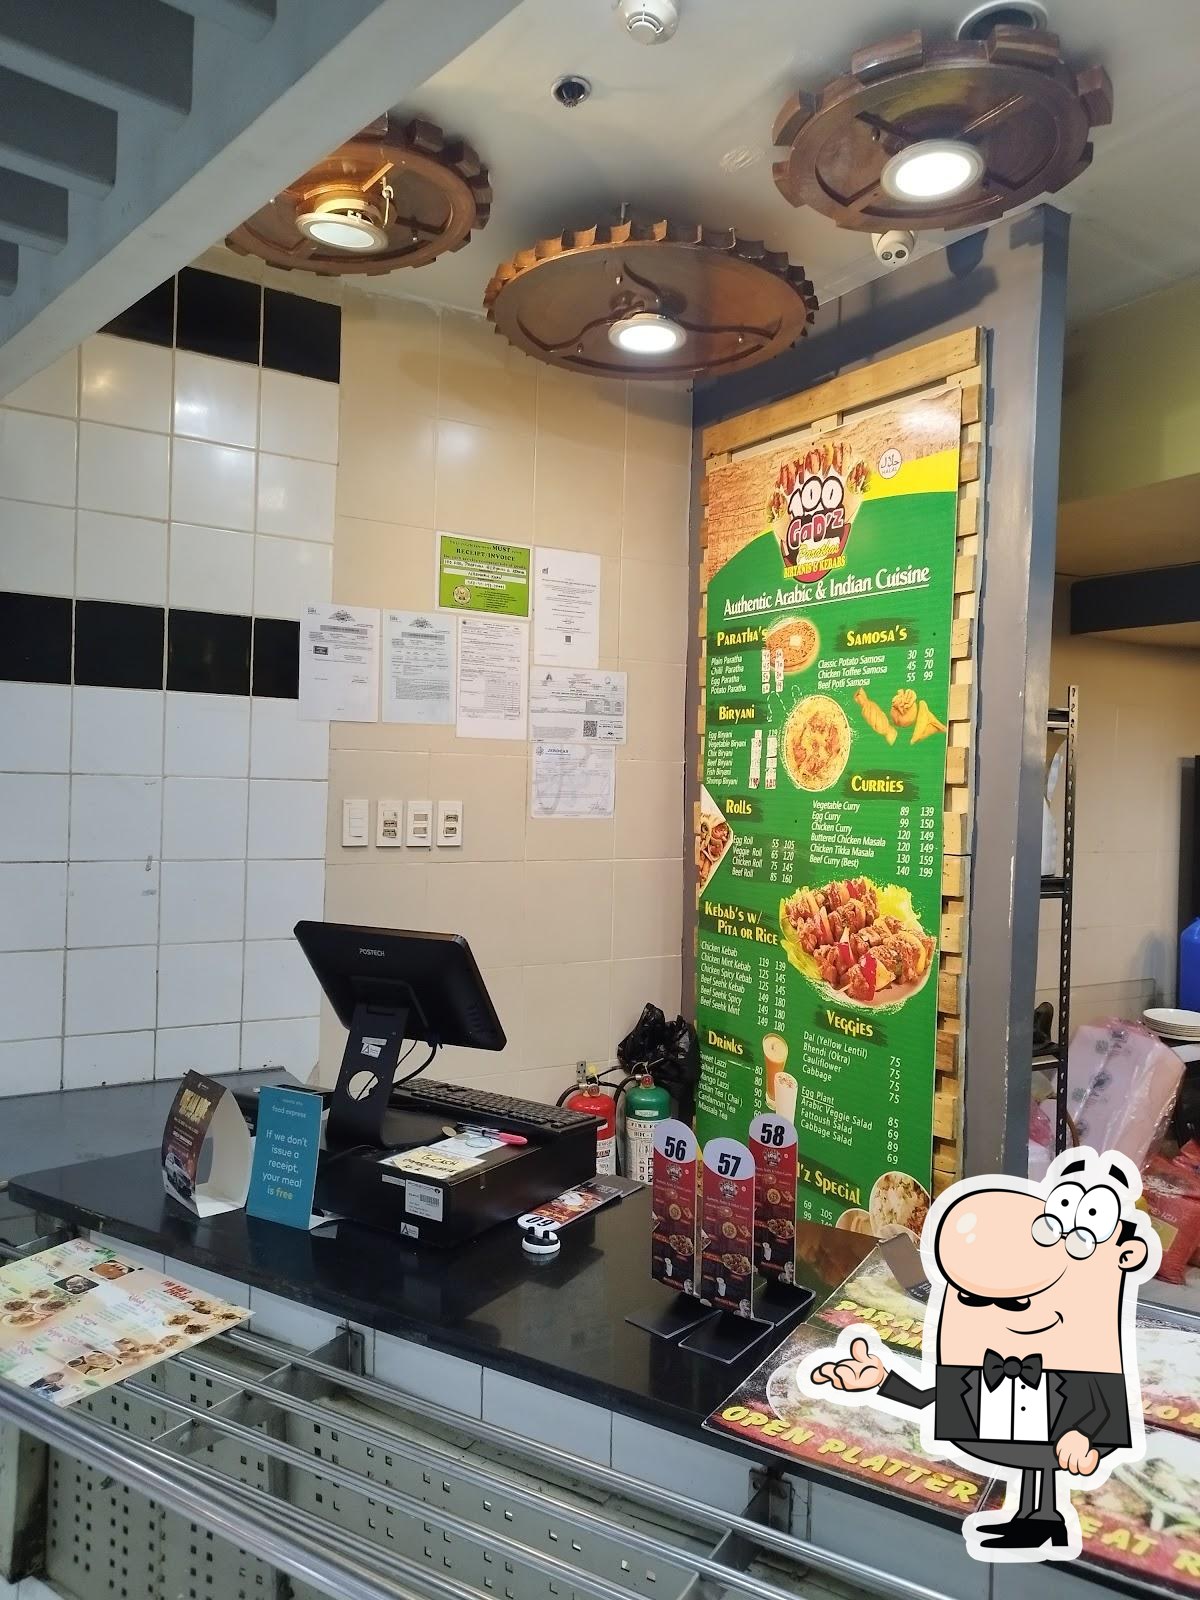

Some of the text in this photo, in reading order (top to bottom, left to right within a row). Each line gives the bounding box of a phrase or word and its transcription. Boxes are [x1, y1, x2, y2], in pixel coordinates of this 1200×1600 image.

[788, 476, 844, 518] 100
[723, 565, 931, 617] Authentic Arabic & Indian Cuisine
[907, 648, 934, 660] 30 50
[818, 655, 885, 669] Classic Potato Samosa
[906, 660, 934, 670] 45 70
[818, 669, 840, 679] Chicken
[862, 666, 887, 675] Samosa
[906, 671, 934, 682] 55 99
[818, 681, 830, 690] Beef
[846, 678, 870, 687] Samosa
[812, 800, 860, 812] Vegetable Curry
[900, 807, 935, 817] 89 139
[812, 811, 841, 823] Egg Curry
[900, 819, 935, 829] 99 150
[811, 822, 852, 836] Chicken Curry
[897, 830, 935, 841] 120 149
[772, 839, 795, 850] 55 105
[810, 833, 886, 847] Buttered Chicken Masala
[810, 844, 875, 858] Chicken Tikka Masala
[897, 842, 934, 853] 120 149
[771, 850, 795, 861] 65 120
[809, 854, 859, 869] Beef Curry (Best)
[896, 854, 934, 866] 130 159
[771, 861, 794, 872] 75 145
[896, 866, 934, 878] 140 199
[359, 947, 385, 957] POSTECH
[701, 941, 738, 957] Chicken Kebab
[701, 952, 752, 972] Chicken Mint Kebab
[759, 957, 786, 972] 119 139
[701, 963, 753, 984] Chicken Spicy Kebab
[759, 969, 786, 984] 125 145
[701, 974, 712, 985] Beef
[728, 981, 745, 994] Kebab
[759, 981, 786, 996] 125 145
[701, 985, 712, 996] Beef
[728, 993, 743, 1007] Spicy
[759, 992, 786, 1008] 149 180
[701, 996, 712, 1007] Beef
[728, 1003, 740, 1016] Mint
[758, 1004, 786, 1020] 149 180
[757, 1016, 785, 1032] 149 180
[803, 1031, 868, 1059] Dal (Yellow Lentil)
[803, 1042, 851, 1066] Bhendi (Okra)
[802, 1053, 842, 1073] Cauliflower
[890, 1056, 901, 1068] 75
[802, 1065, 832, 1083] Cabbage
[889, 1068, 900, 1079] 75
[754, 1077, 762, 1087] 80
[890, 1080, 900, 1091] 75
[754, 1088, 762, 1098] 90
[801, 1086, 835, 1105] Egg Plant
[889, 1092, 899, 1104] 75
[272, 1105, 306, 1119] food express
[801, 1098, 873, 1130] Arabic Veggie Salad
[801, 1108, 852, 1135] Fattoush Salad
[887, 1117, 899, 1128] 85
[266, 1129, 308, 1147] If we don't
[760, 1123, 785, 1147] 58
[801, 1120, 853, 1146] Cabbage Salad
[887, 1129, 899, 1141] 69
[271, 1144, 292, 1158] issue
[664, 1135, 688, 1162] 56
[887, 1141, 898, 1152] 89
[717, 1152, 742, 1178] 57
[887, 1153, 898, 1165] 69
[268, 1159, 299, 1174] receipt,
[262, 1172, 302, 1188] your meal
[267, 1185, 294, 1200] is free
[803, 1200, 812, 1210] 69
[721, 1405, 978, 1504] OPEN PLATTER
